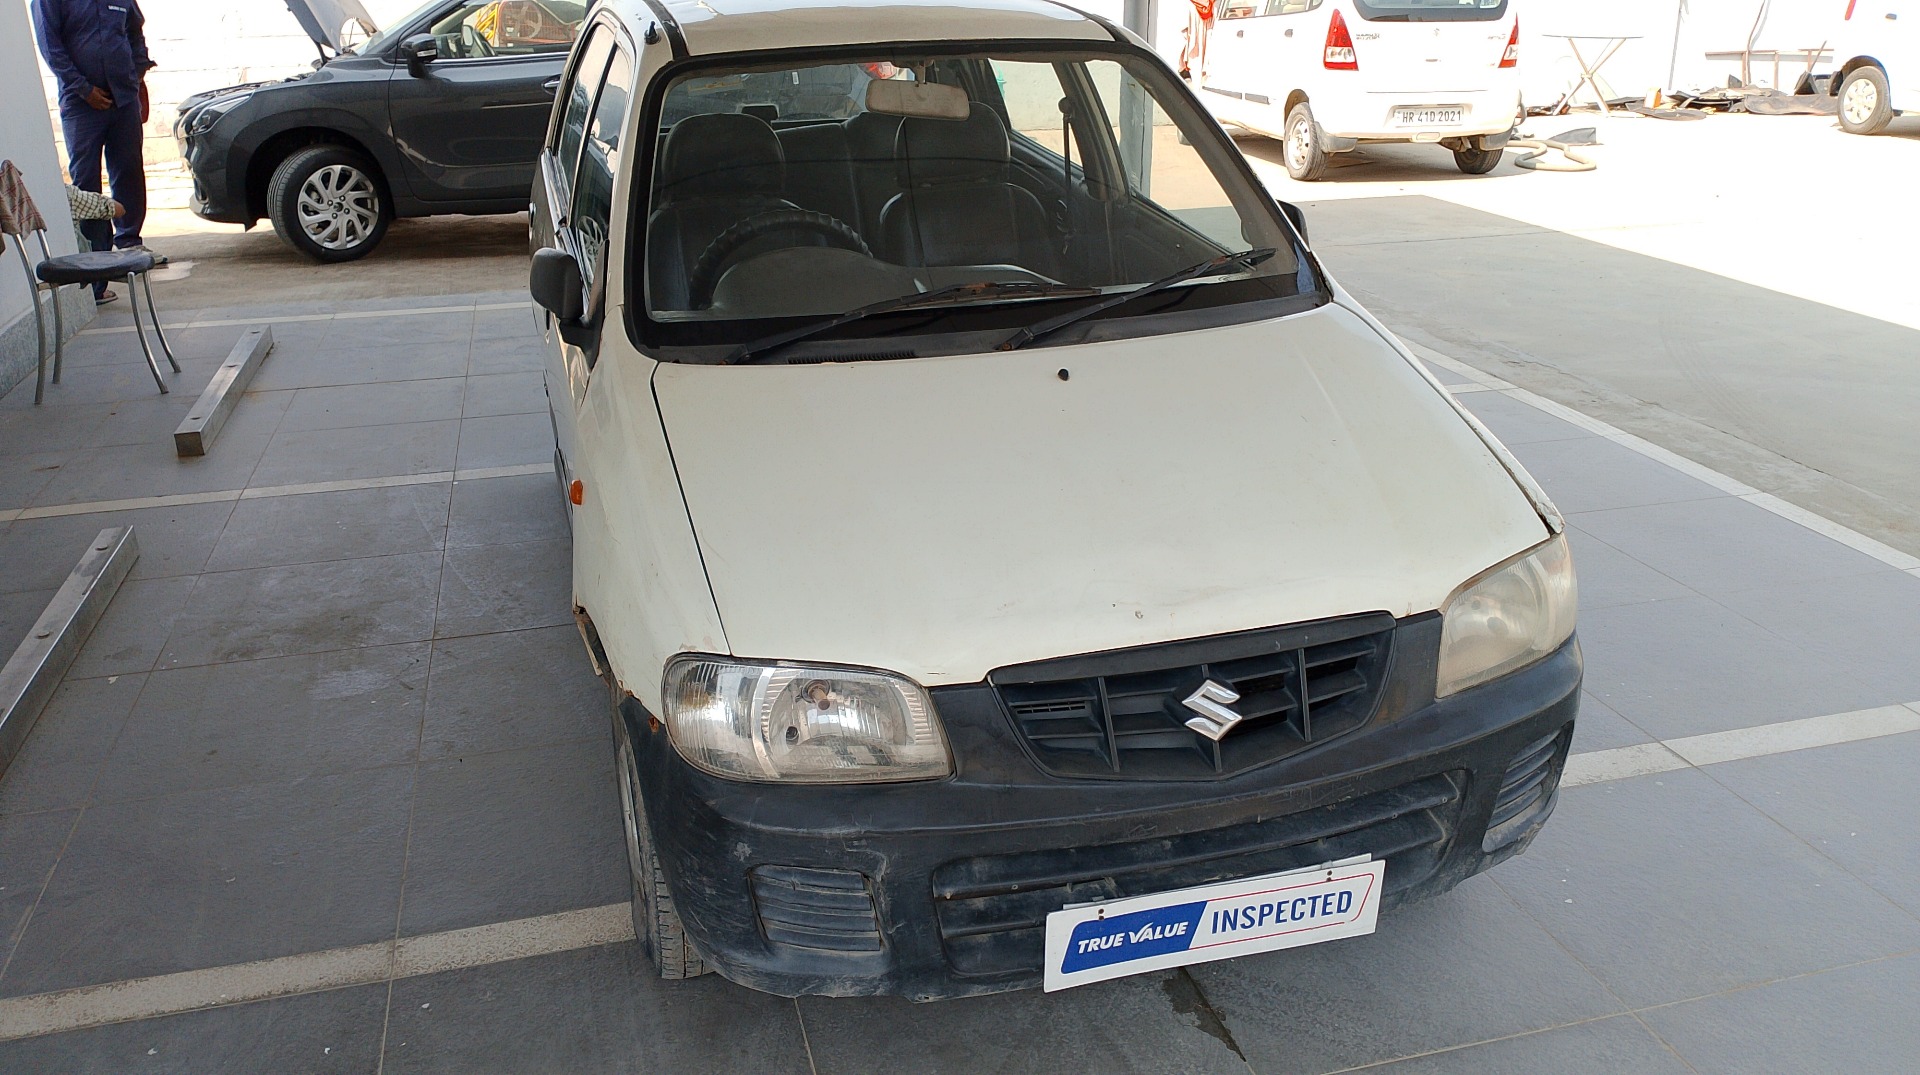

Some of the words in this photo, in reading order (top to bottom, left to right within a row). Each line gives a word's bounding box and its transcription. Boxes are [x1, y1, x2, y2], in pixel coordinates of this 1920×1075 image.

[1402, 112, 1414, 123] HR
[1418, 111, 1435, 122] 41D
[1438, 110, 1461, 122] 2021
[1078, 932, 1125, 954] TRUE
[1128, 921, 1189, 944] VALUE
[1211, 890, 1353, 934] INSPECTED
